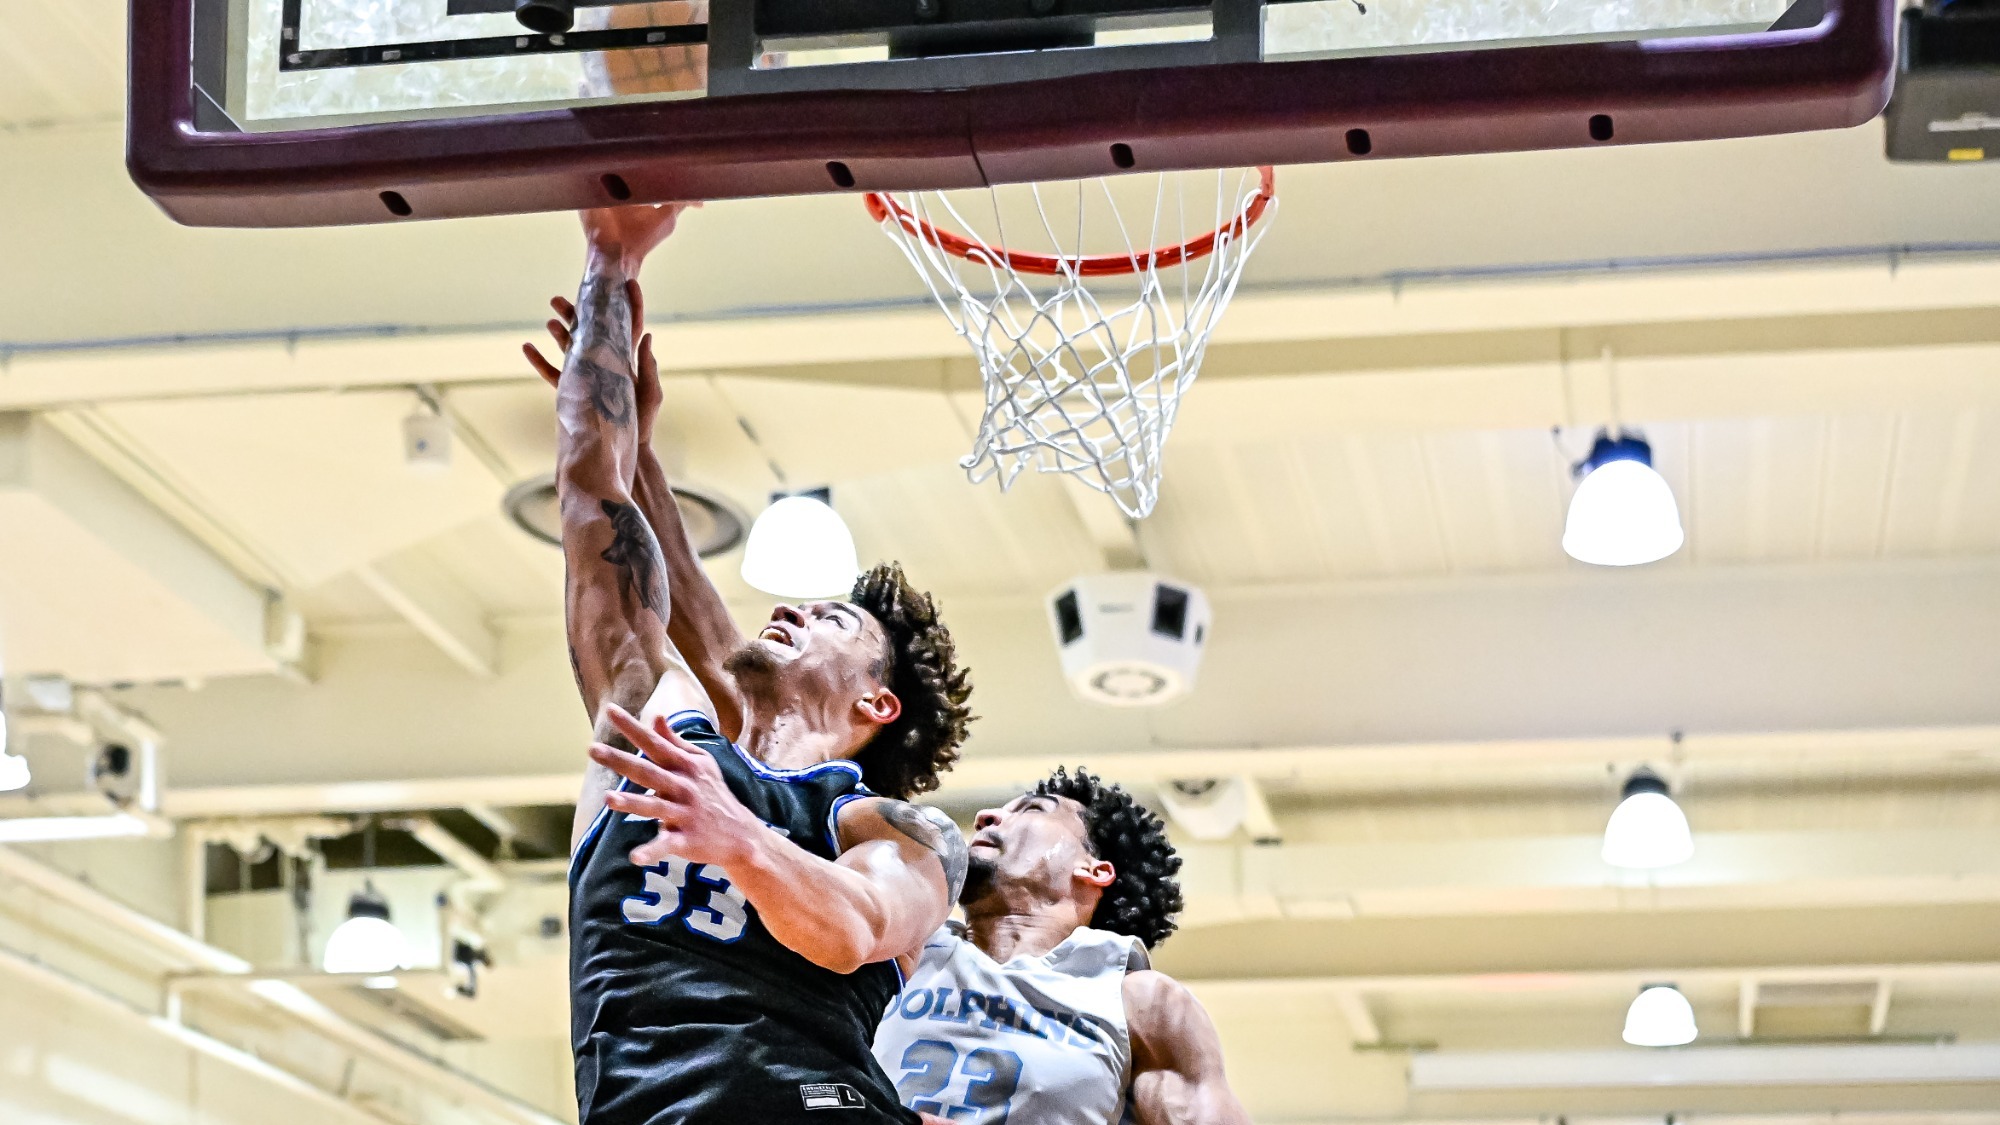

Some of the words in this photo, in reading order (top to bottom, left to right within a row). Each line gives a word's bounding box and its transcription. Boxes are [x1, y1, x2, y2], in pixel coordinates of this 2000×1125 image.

[620, 854, 748, 944] 33
[846, 1089, 857, 1102] L
[895, 1039, 1024, 1125] 23
